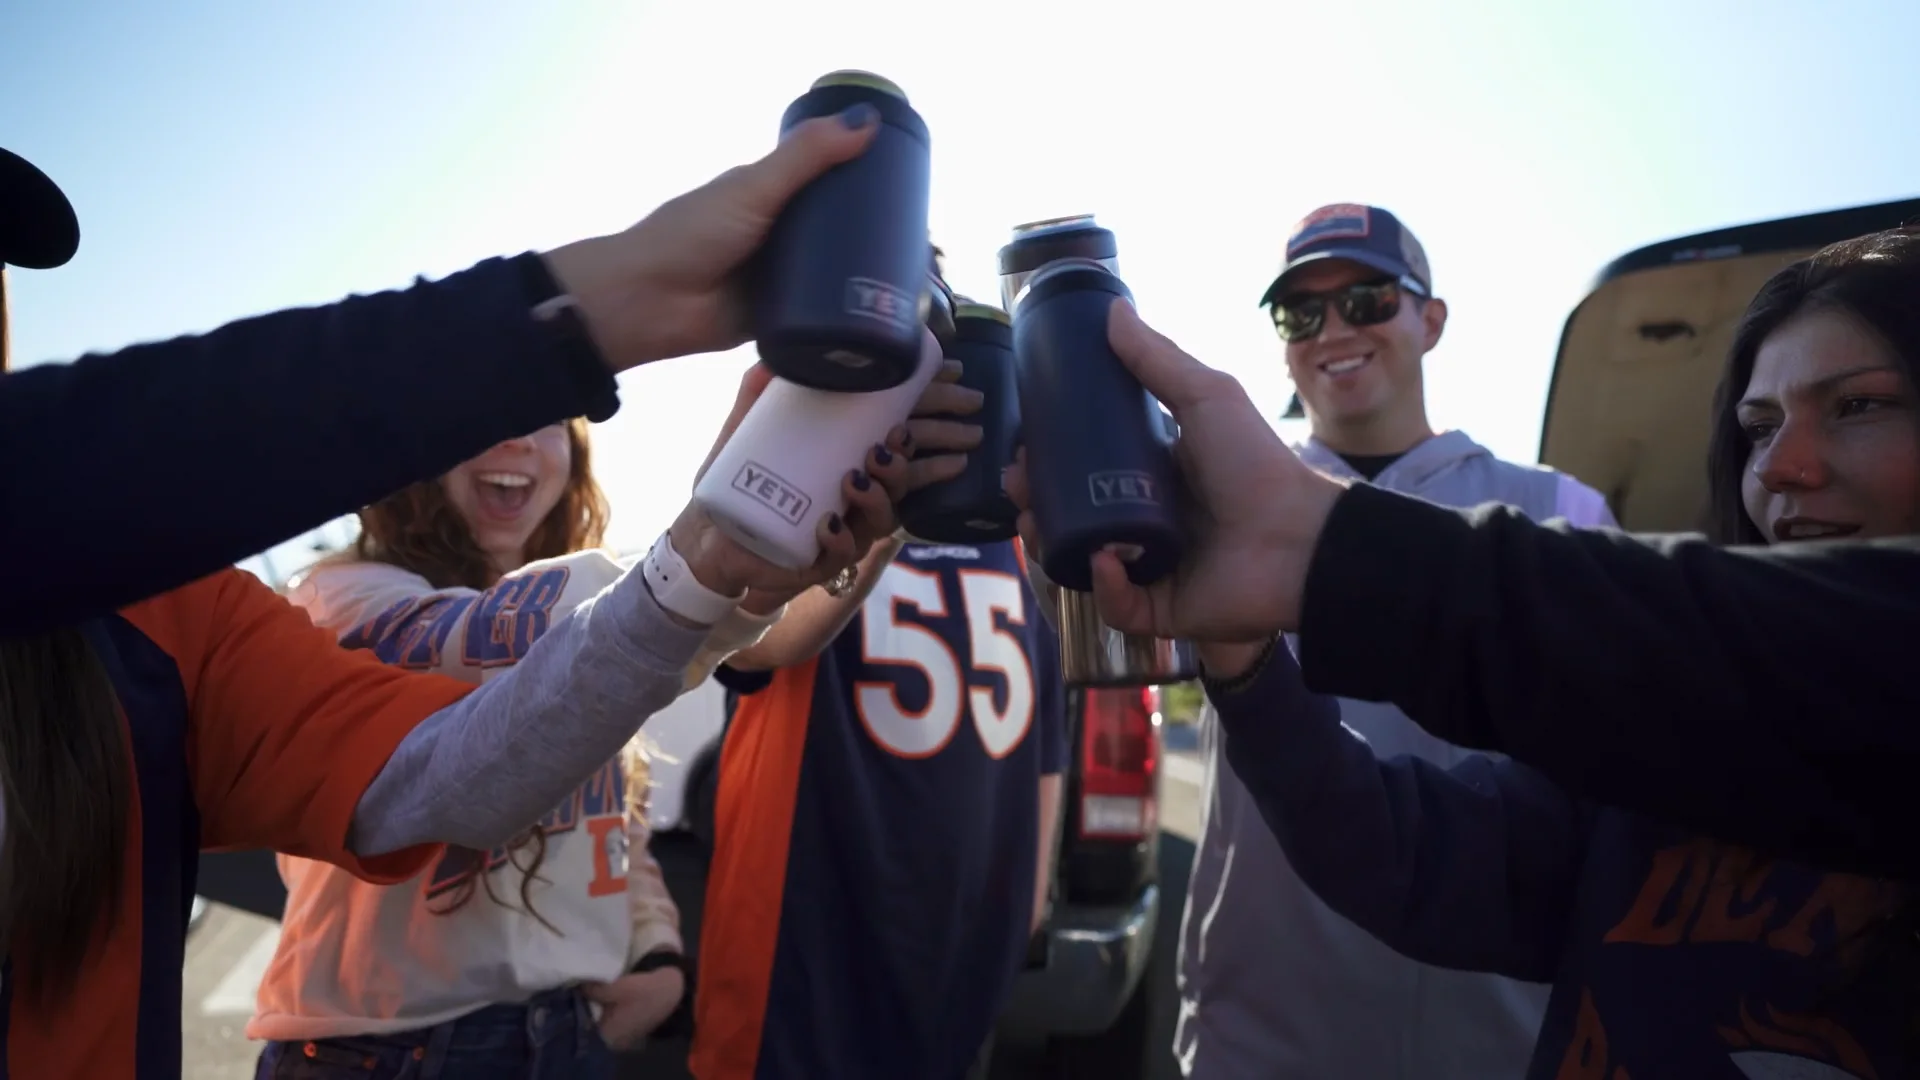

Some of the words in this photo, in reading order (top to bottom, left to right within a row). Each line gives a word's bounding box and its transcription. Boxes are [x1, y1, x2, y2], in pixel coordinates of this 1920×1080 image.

[851, 283, 914, 320] YET
[744, 467, 804, 517] YETI
[1096, 476, 1154, 500] YET
[339, 566, 571, 668] DENER
[853, 562, 1036, 760] 55
